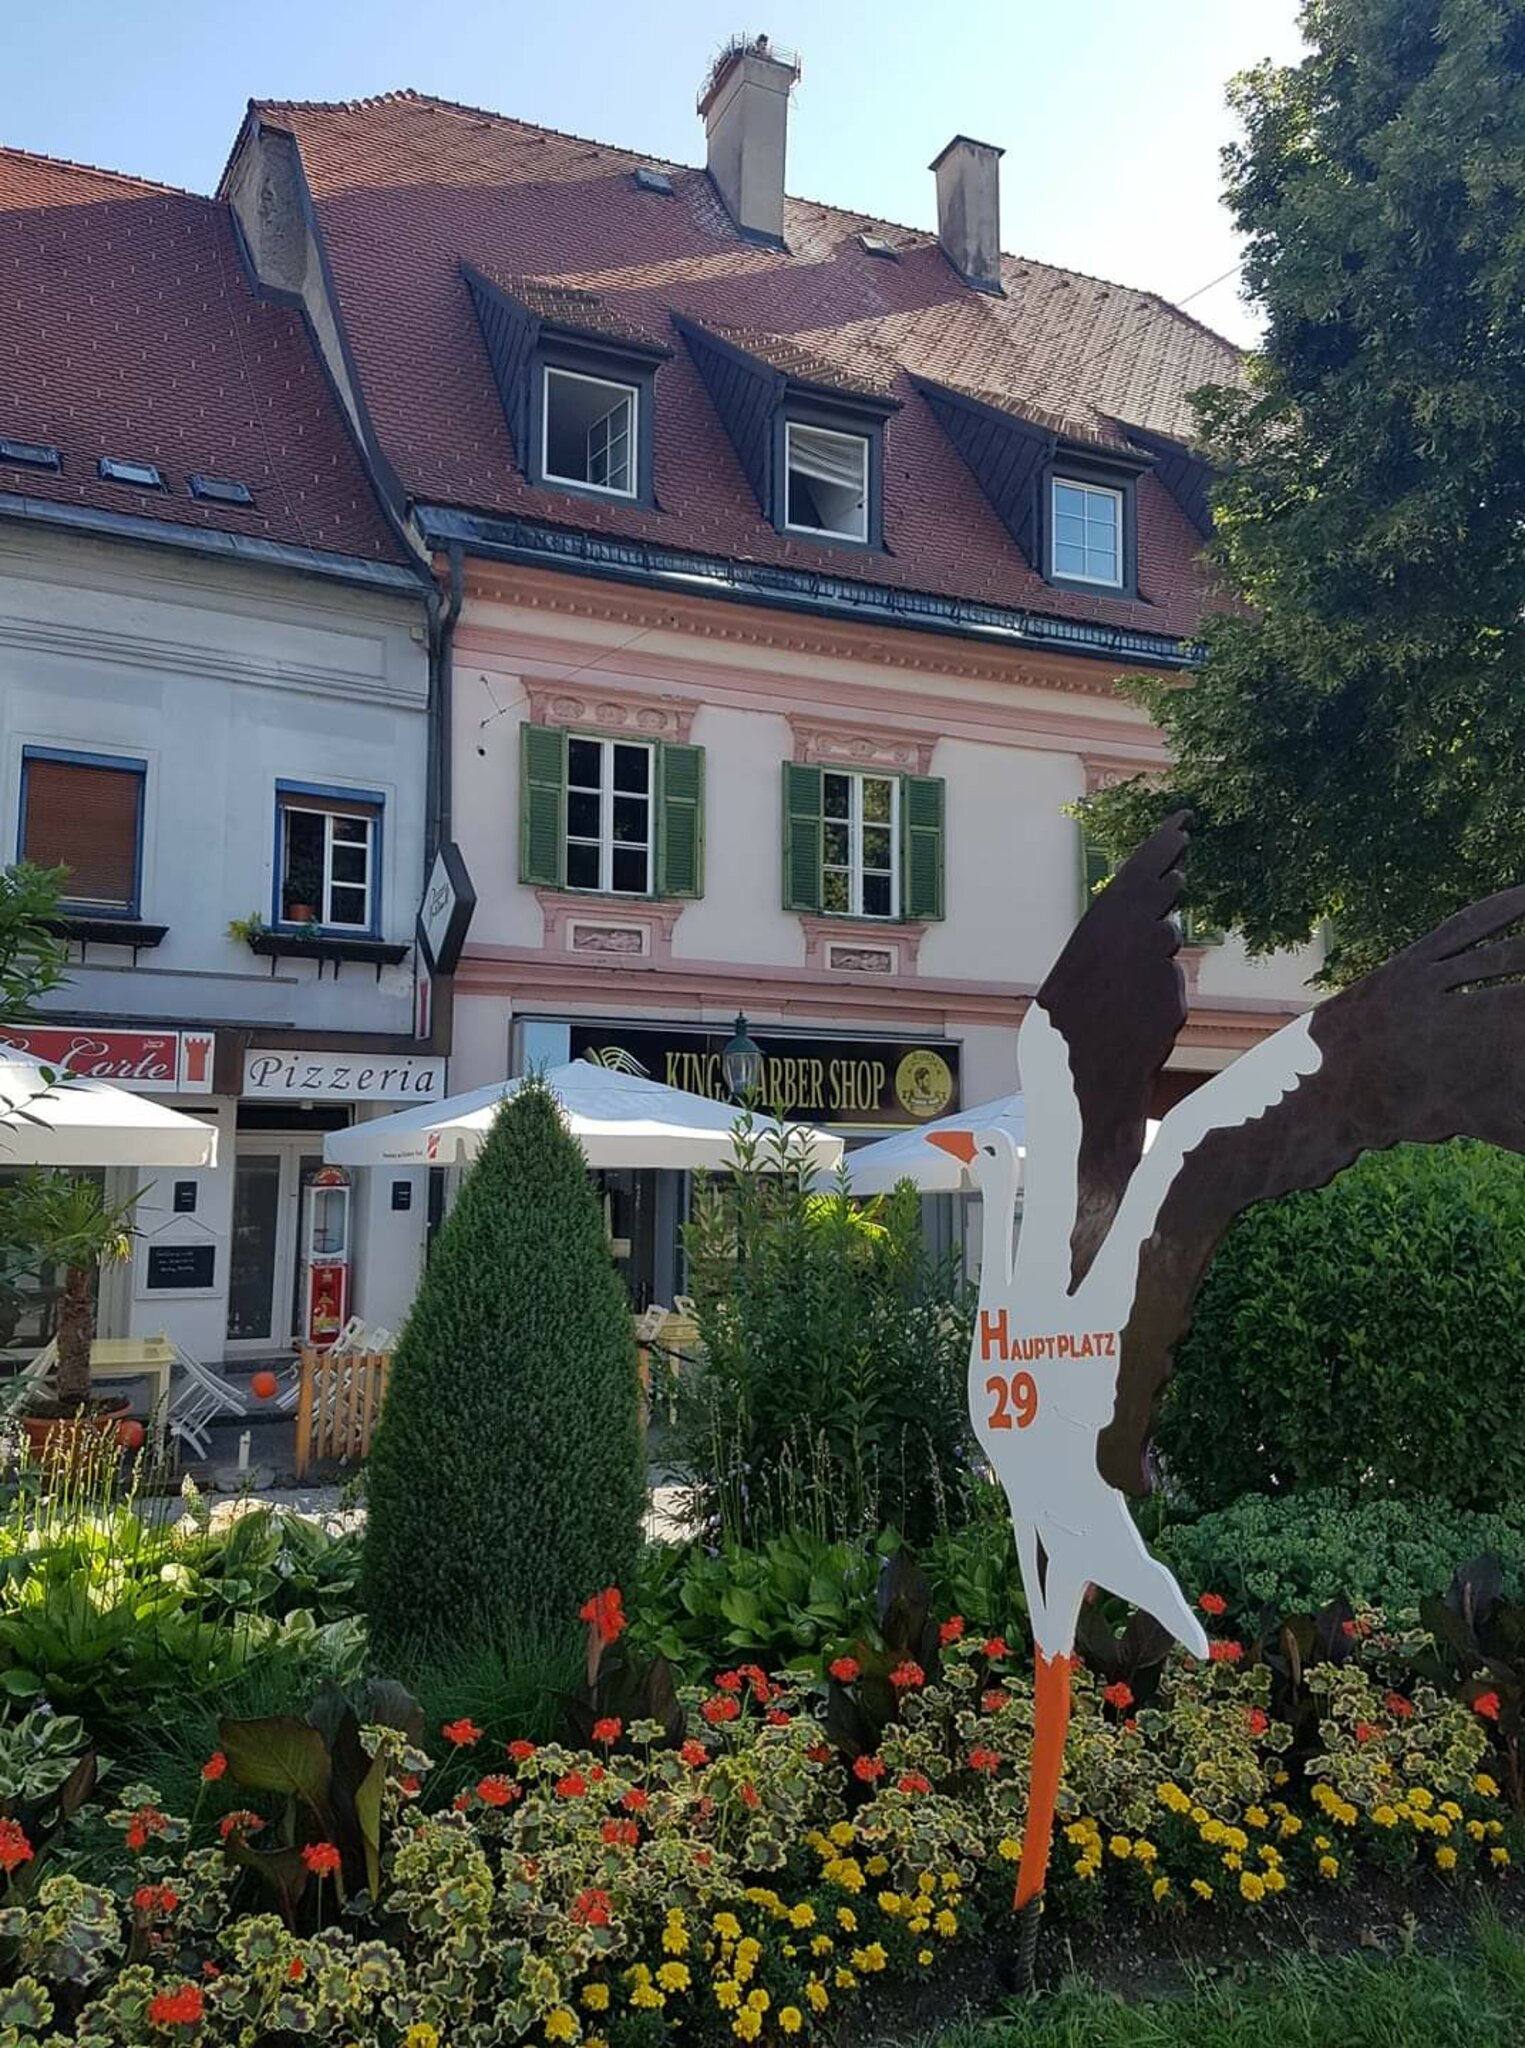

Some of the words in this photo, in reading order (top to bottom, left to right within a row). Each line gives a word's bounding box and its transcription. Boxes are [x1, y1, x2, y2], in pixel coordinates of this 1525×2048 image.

[250, 1056, 434, 1092] Pizzeria
[829, 1060, 885, 1111] SHOP
[986, 1371, 1038, 1429] 29
